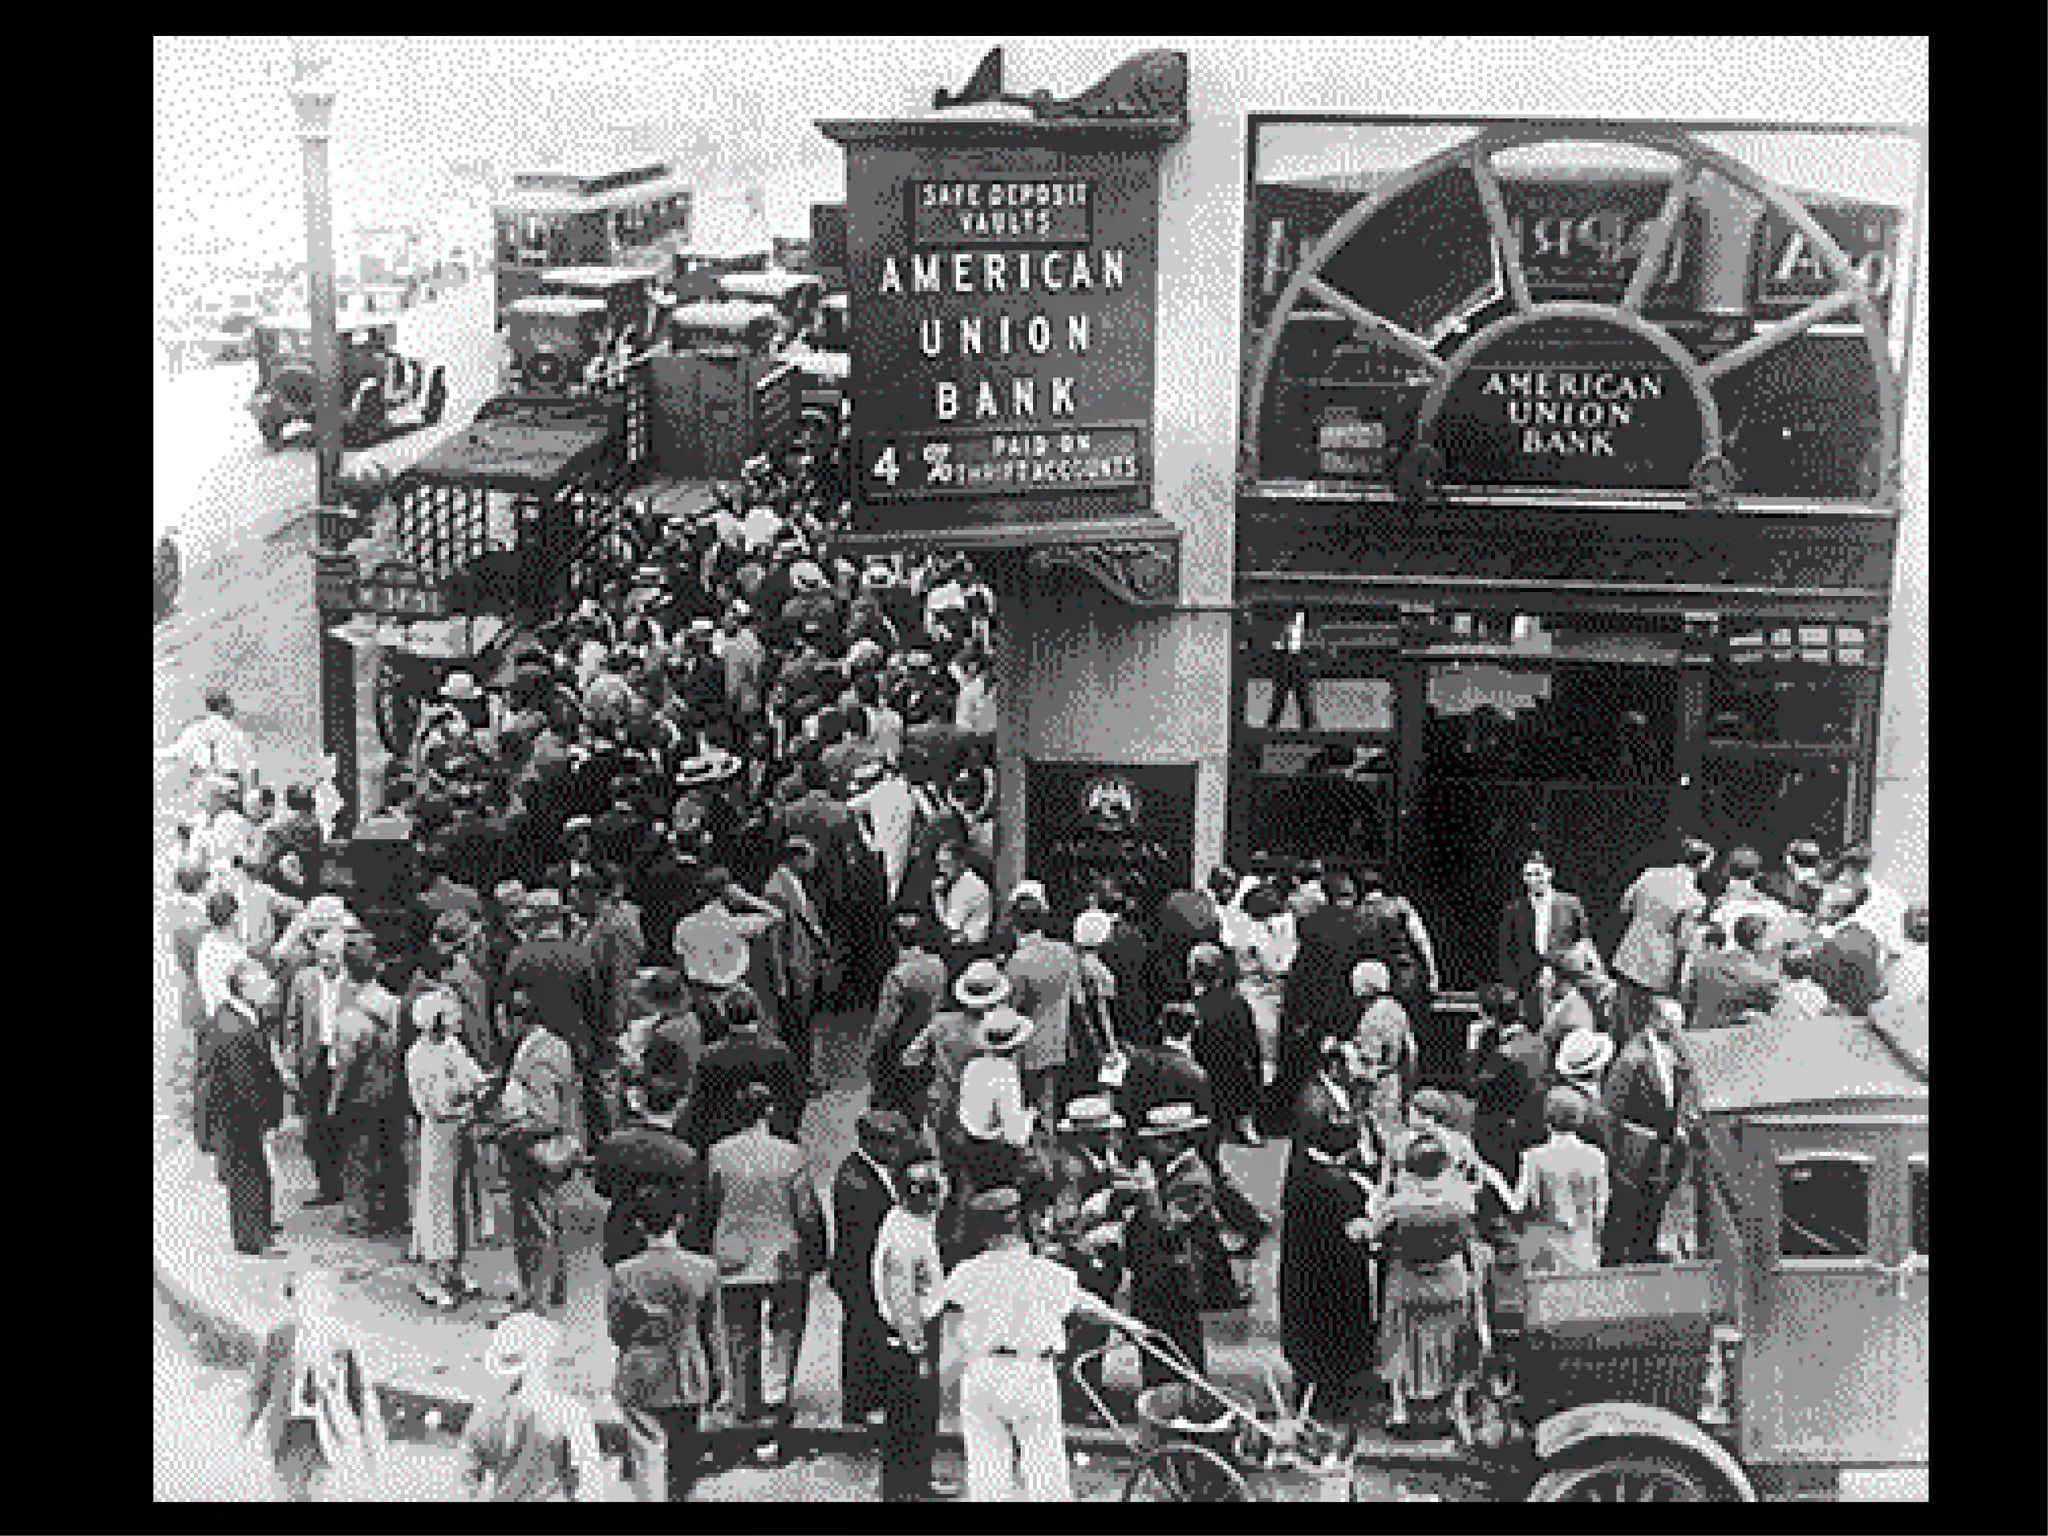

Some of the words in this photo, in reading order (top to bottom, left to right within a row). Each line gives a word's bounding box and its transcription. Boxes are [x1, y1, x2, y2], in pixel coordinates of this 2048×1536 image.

[923, 183, 981, 205] SAFE
[988, 183, 1088, 206] DEPOSIT
[960, 210, 1053, 234] VAULTS
[881, 252, 1124, 291] AMERICAN
[920, 315, 1089, 355] UNION
[938, 377, 1075, 418] BANK
[1482, 371, 1663, 400] AMERICAN
[1508, 401, 1633, 428] UNION
[992, 434, 1049, 456] PAID
[1523, 428, 1616, 457] BANK
[873, 446, 900, 485] 4
